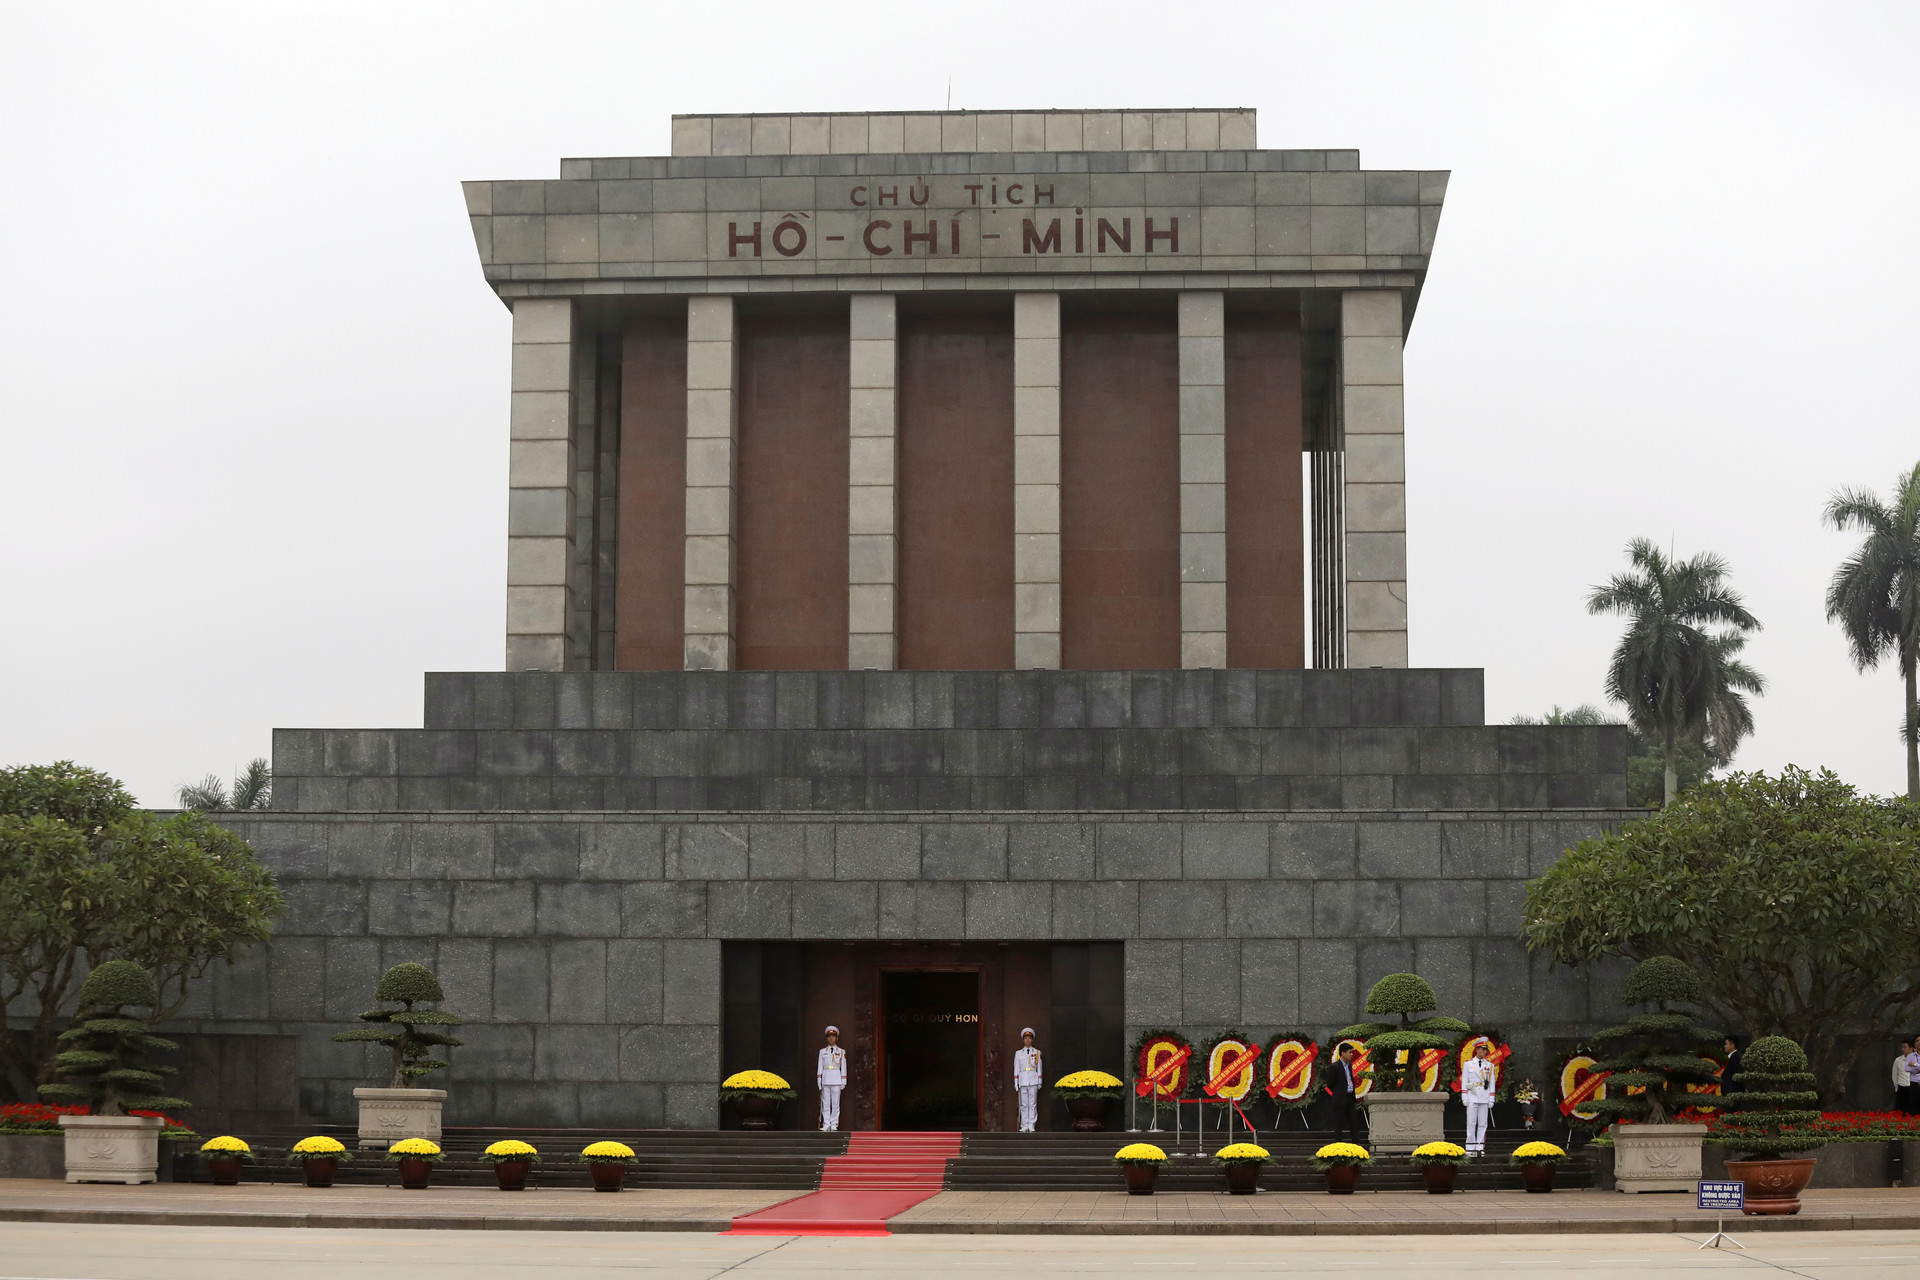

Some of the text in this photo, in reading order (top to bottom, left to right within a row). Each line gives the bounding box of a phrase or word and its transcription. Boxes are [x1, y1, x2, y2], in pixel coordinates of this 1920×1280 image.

[850, 176, 930, 206] CHỦ
[728, 212, 810, 258] HỒ
[862, 210, 961, 256] CHÍ
